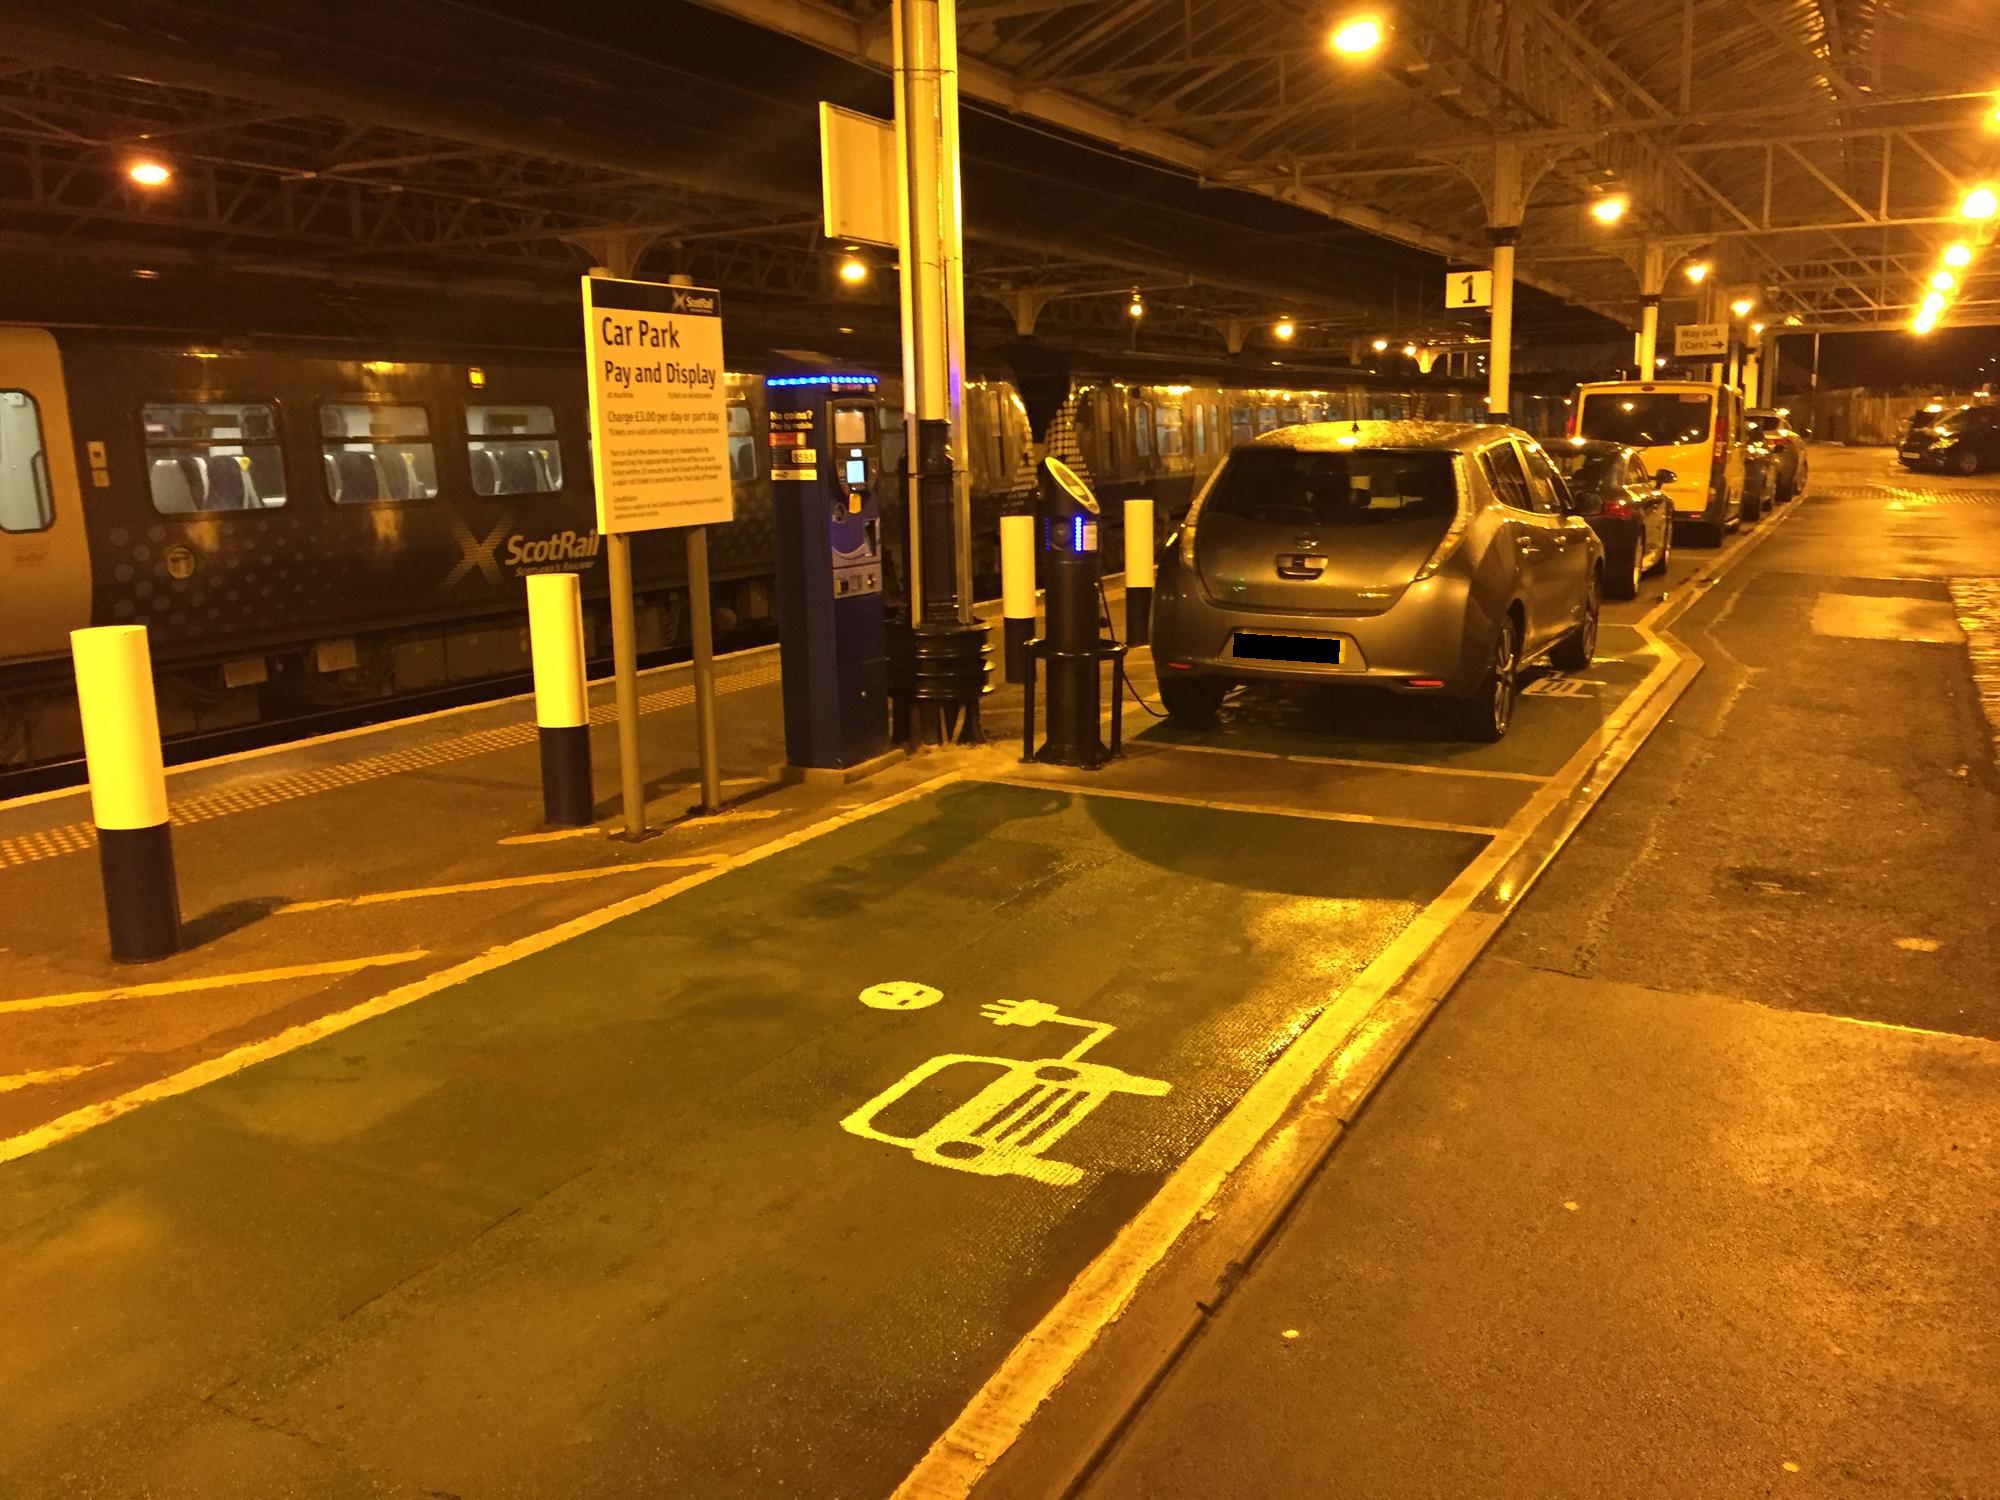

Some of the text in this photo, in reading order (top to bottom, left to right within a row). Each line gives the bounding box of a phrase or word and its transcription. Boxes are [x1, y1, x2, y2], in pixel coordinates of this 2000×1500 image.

[1462, 275, 1476, 304] 1
[602, 317, 680, 348] Car Park
[604, 360, 716, 389] Pay and Display
[770, 411, 783, 420] No
[505, 529, 600, 565] ScotRail
